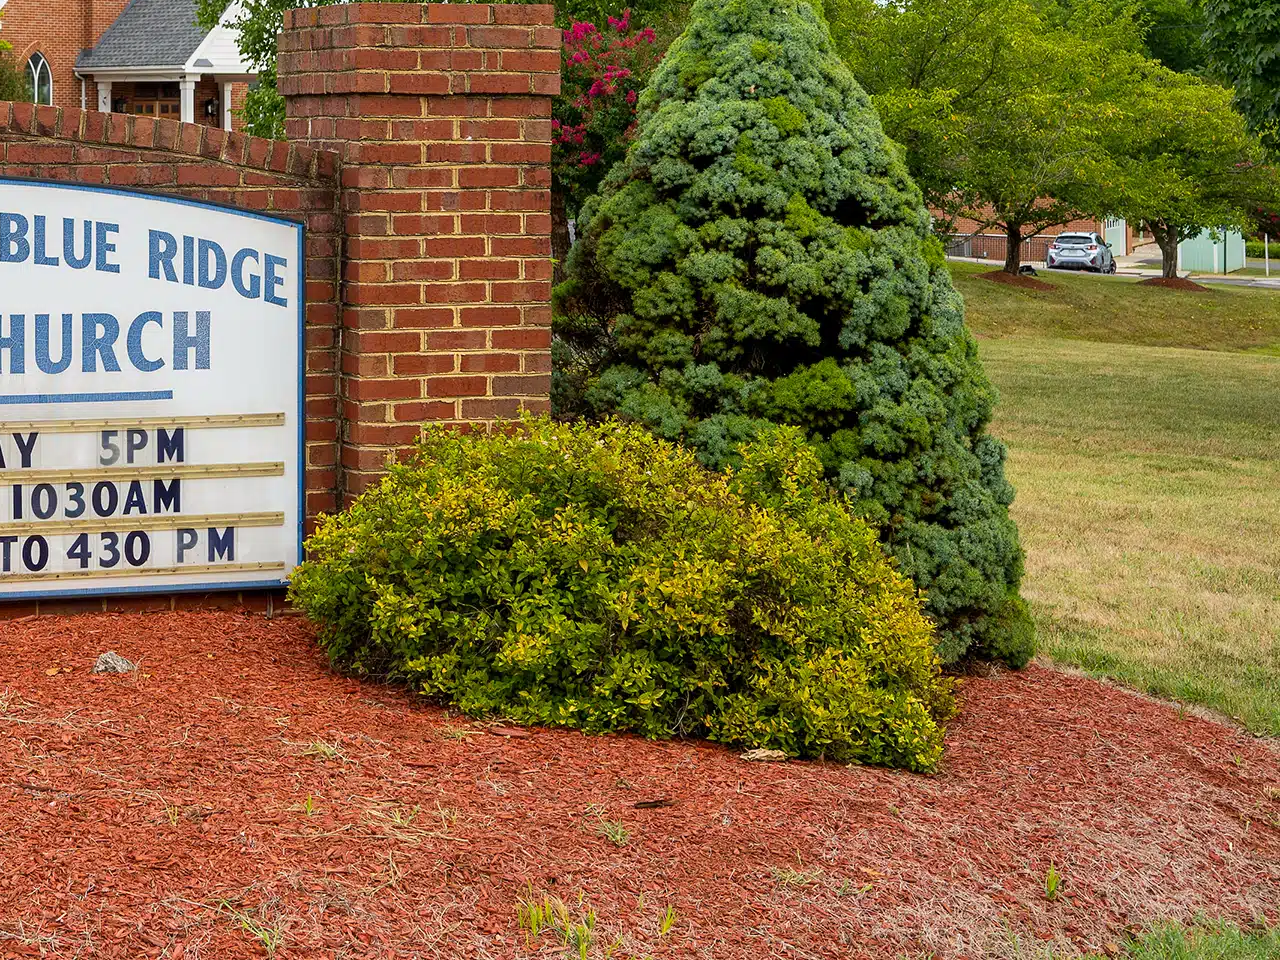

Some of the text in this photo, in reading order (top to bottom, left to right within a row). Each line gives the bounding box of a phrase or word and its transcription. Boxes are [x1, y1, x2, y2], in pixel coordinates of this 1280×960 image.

[0, 211, 120, 274] BLUE
[148, 228, 288, 308] RIDGE
[99, 428, 185, 466] 5PM
[66, 530, 151, 569] 430
[177, 526, 235, 563] PM
